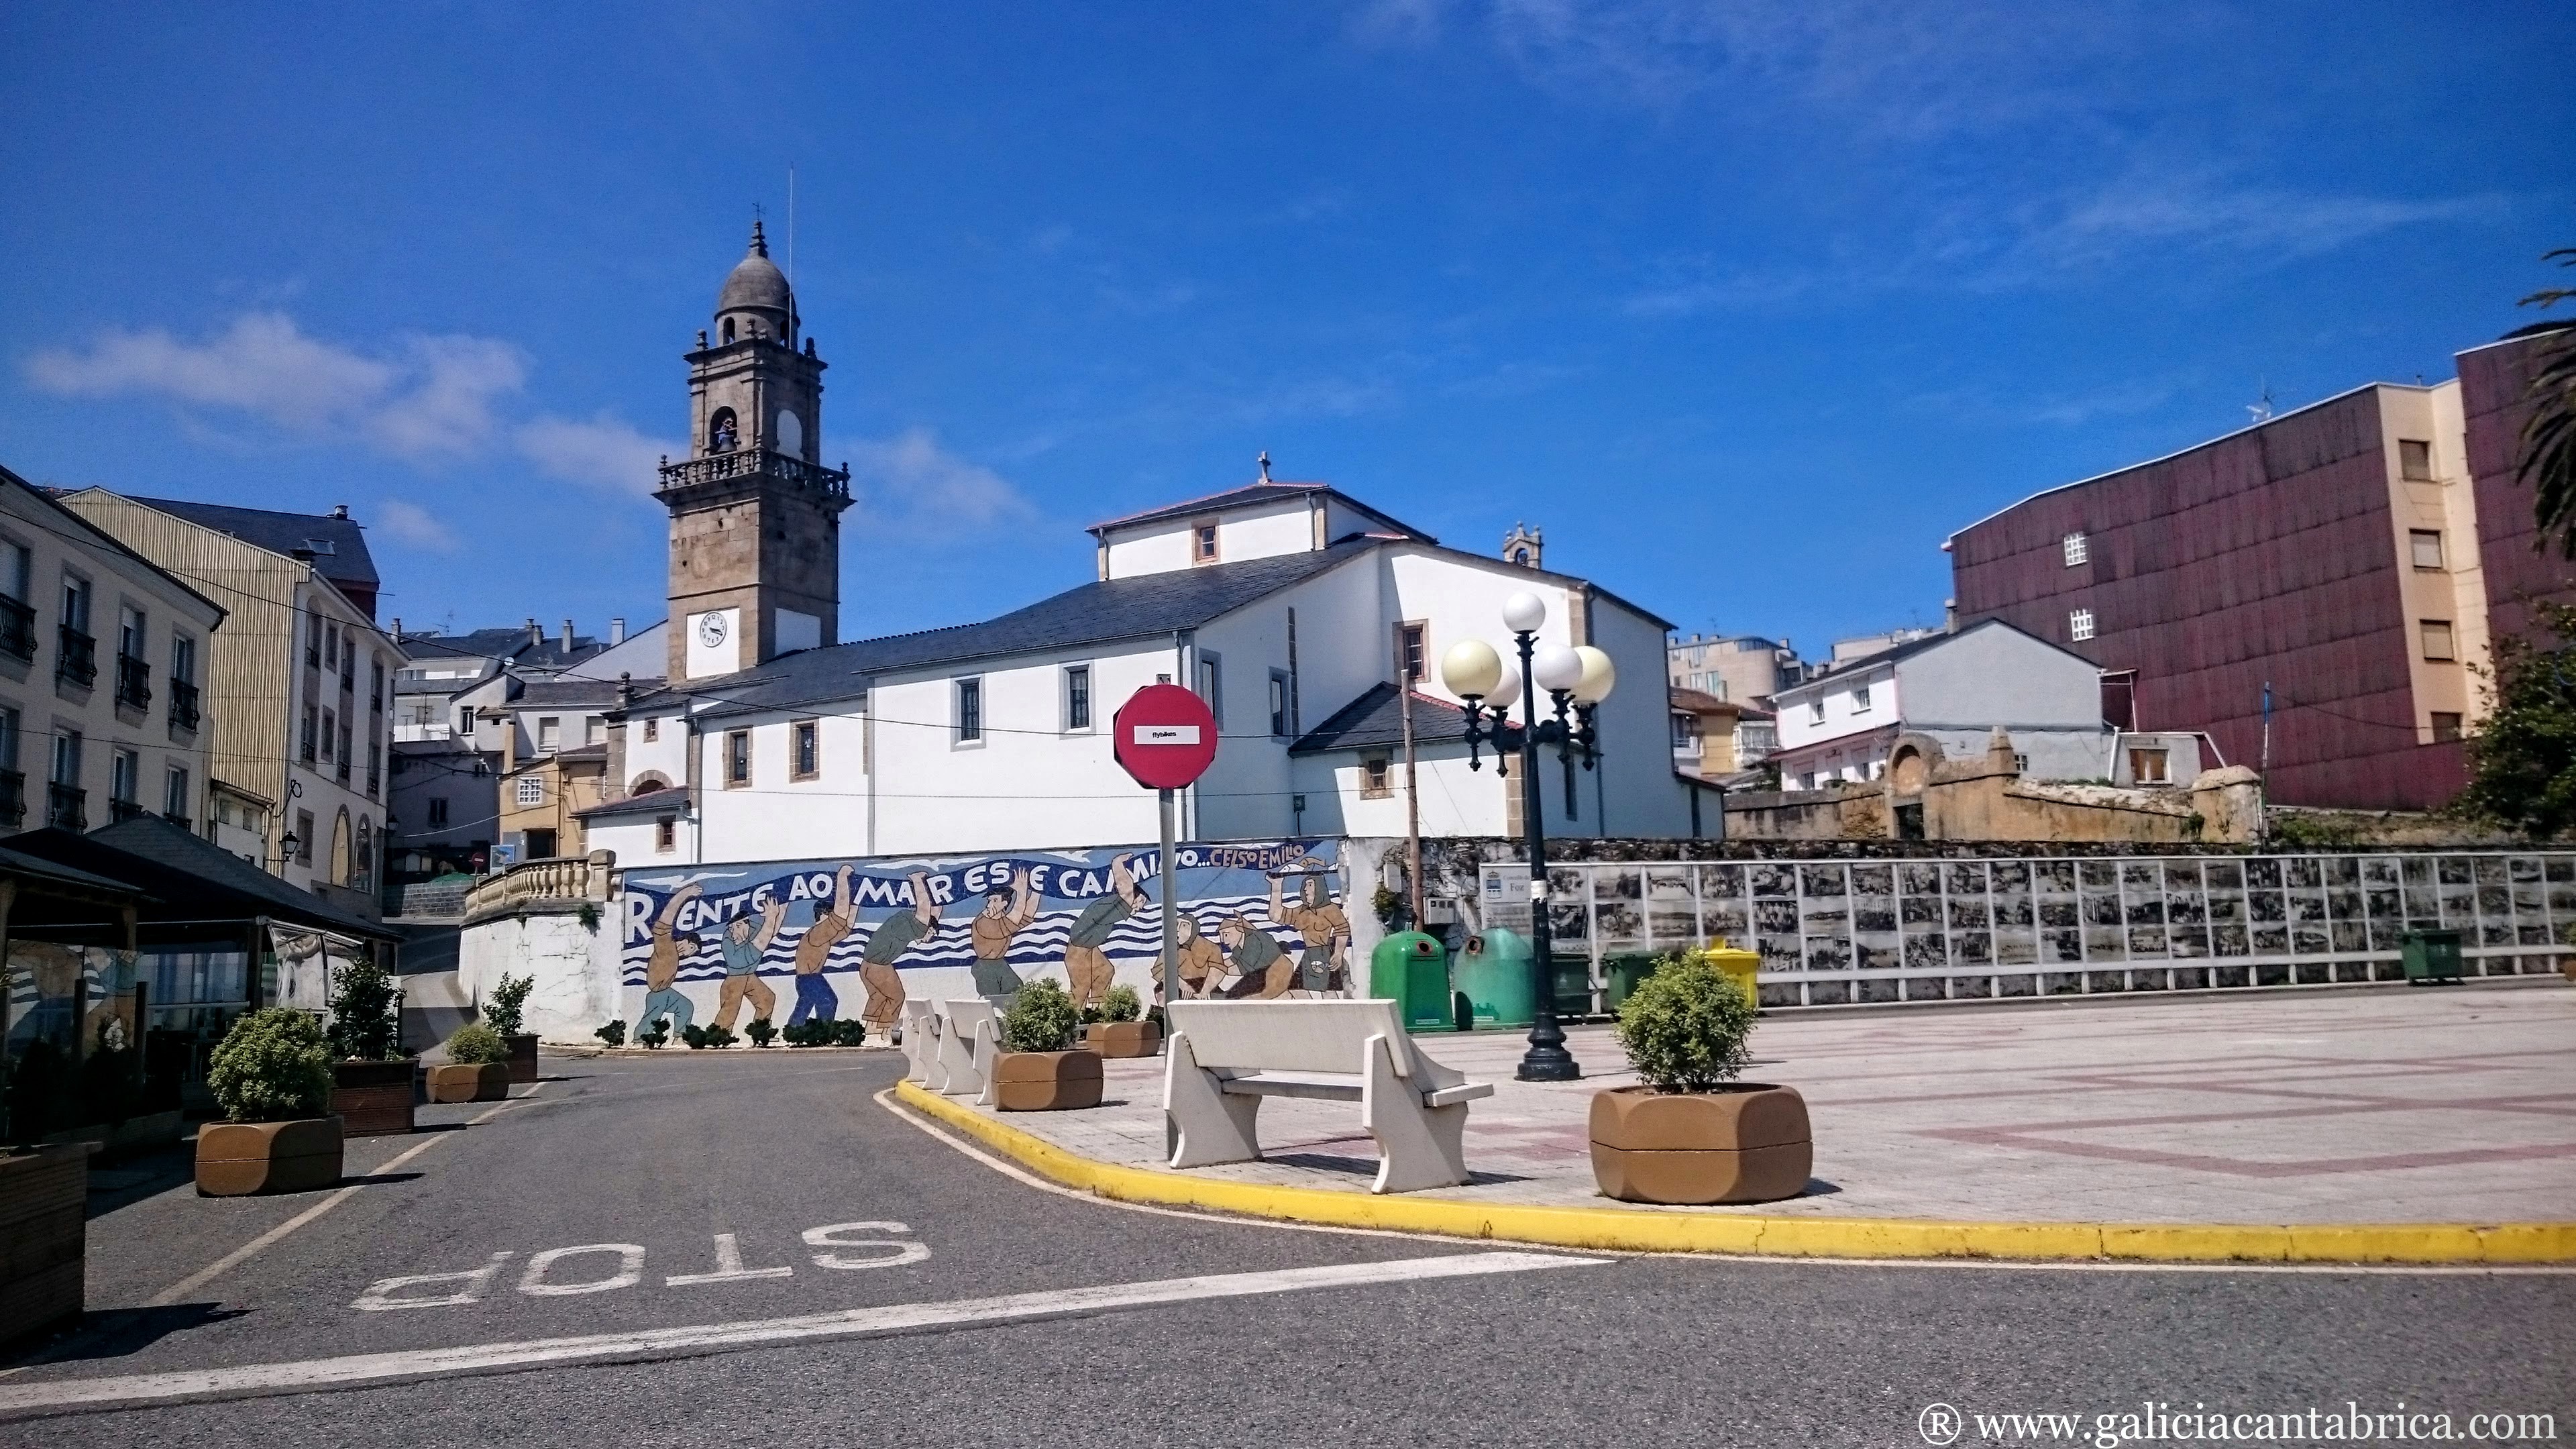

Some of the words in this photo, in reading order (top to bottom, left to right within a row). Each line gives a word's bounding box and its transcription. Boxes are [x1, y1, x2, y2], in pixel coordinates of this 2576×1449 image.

[788, 873, 833, 901] AO
[853, 875, 954, 906] MAR
[964, 862, 1051, 893] ESE
[1210, 849, 1258, 868] CELSO
[1510, 883, 1524, 892] Foz
[350, 1220, 934, 1311] STOP
